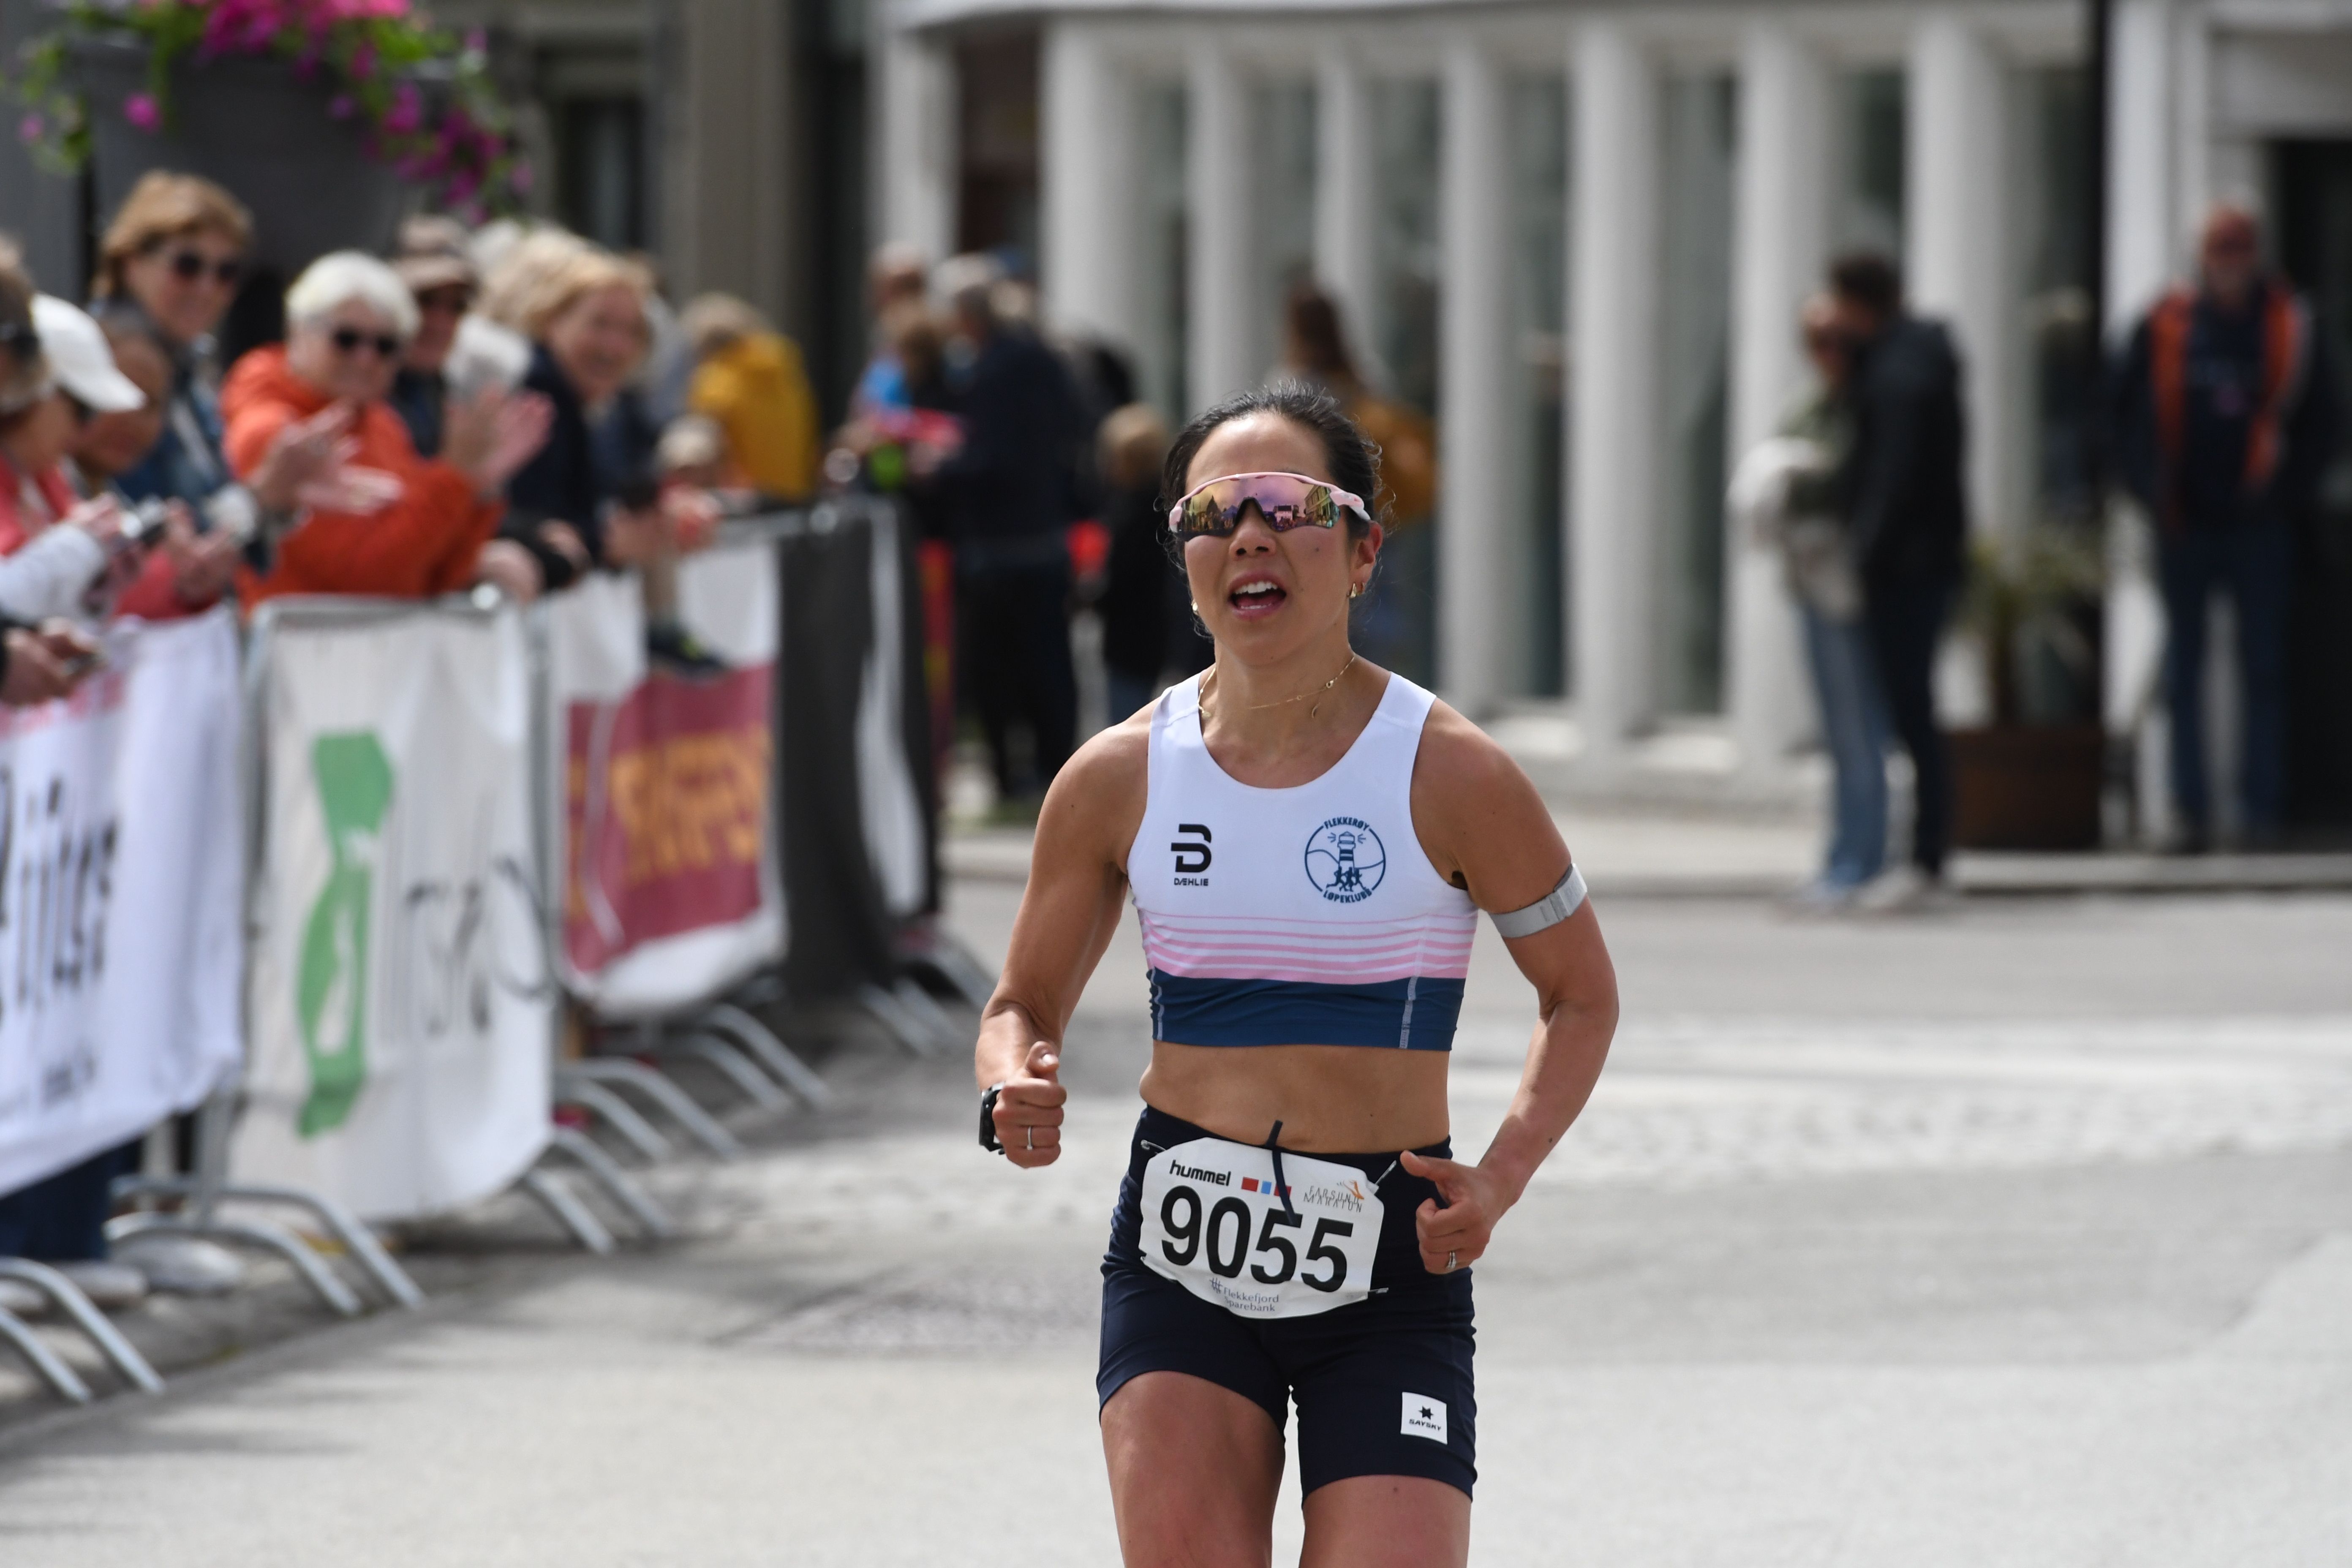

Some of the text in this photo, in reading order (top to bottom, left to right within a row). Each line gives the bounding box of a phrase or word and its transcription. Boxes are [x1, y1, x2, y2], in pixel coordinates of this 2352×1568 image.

[1324, 817, 1369, 831] FLEKKERØY
[1174, 877, 1209, 886] DÆHLIE
[1323, 888, 1372, 903] LØPEKLUBB
[1169, 1159, 1231, 1186] hummel
[1303, 1192, 1362, 1212] MARATON
[1161, 1185, 1354, 1293] 9055
[1224, 1287, 1279, 1304] Flekkefjord
[1409, 1418, 1441, 1431] SAYSKY
